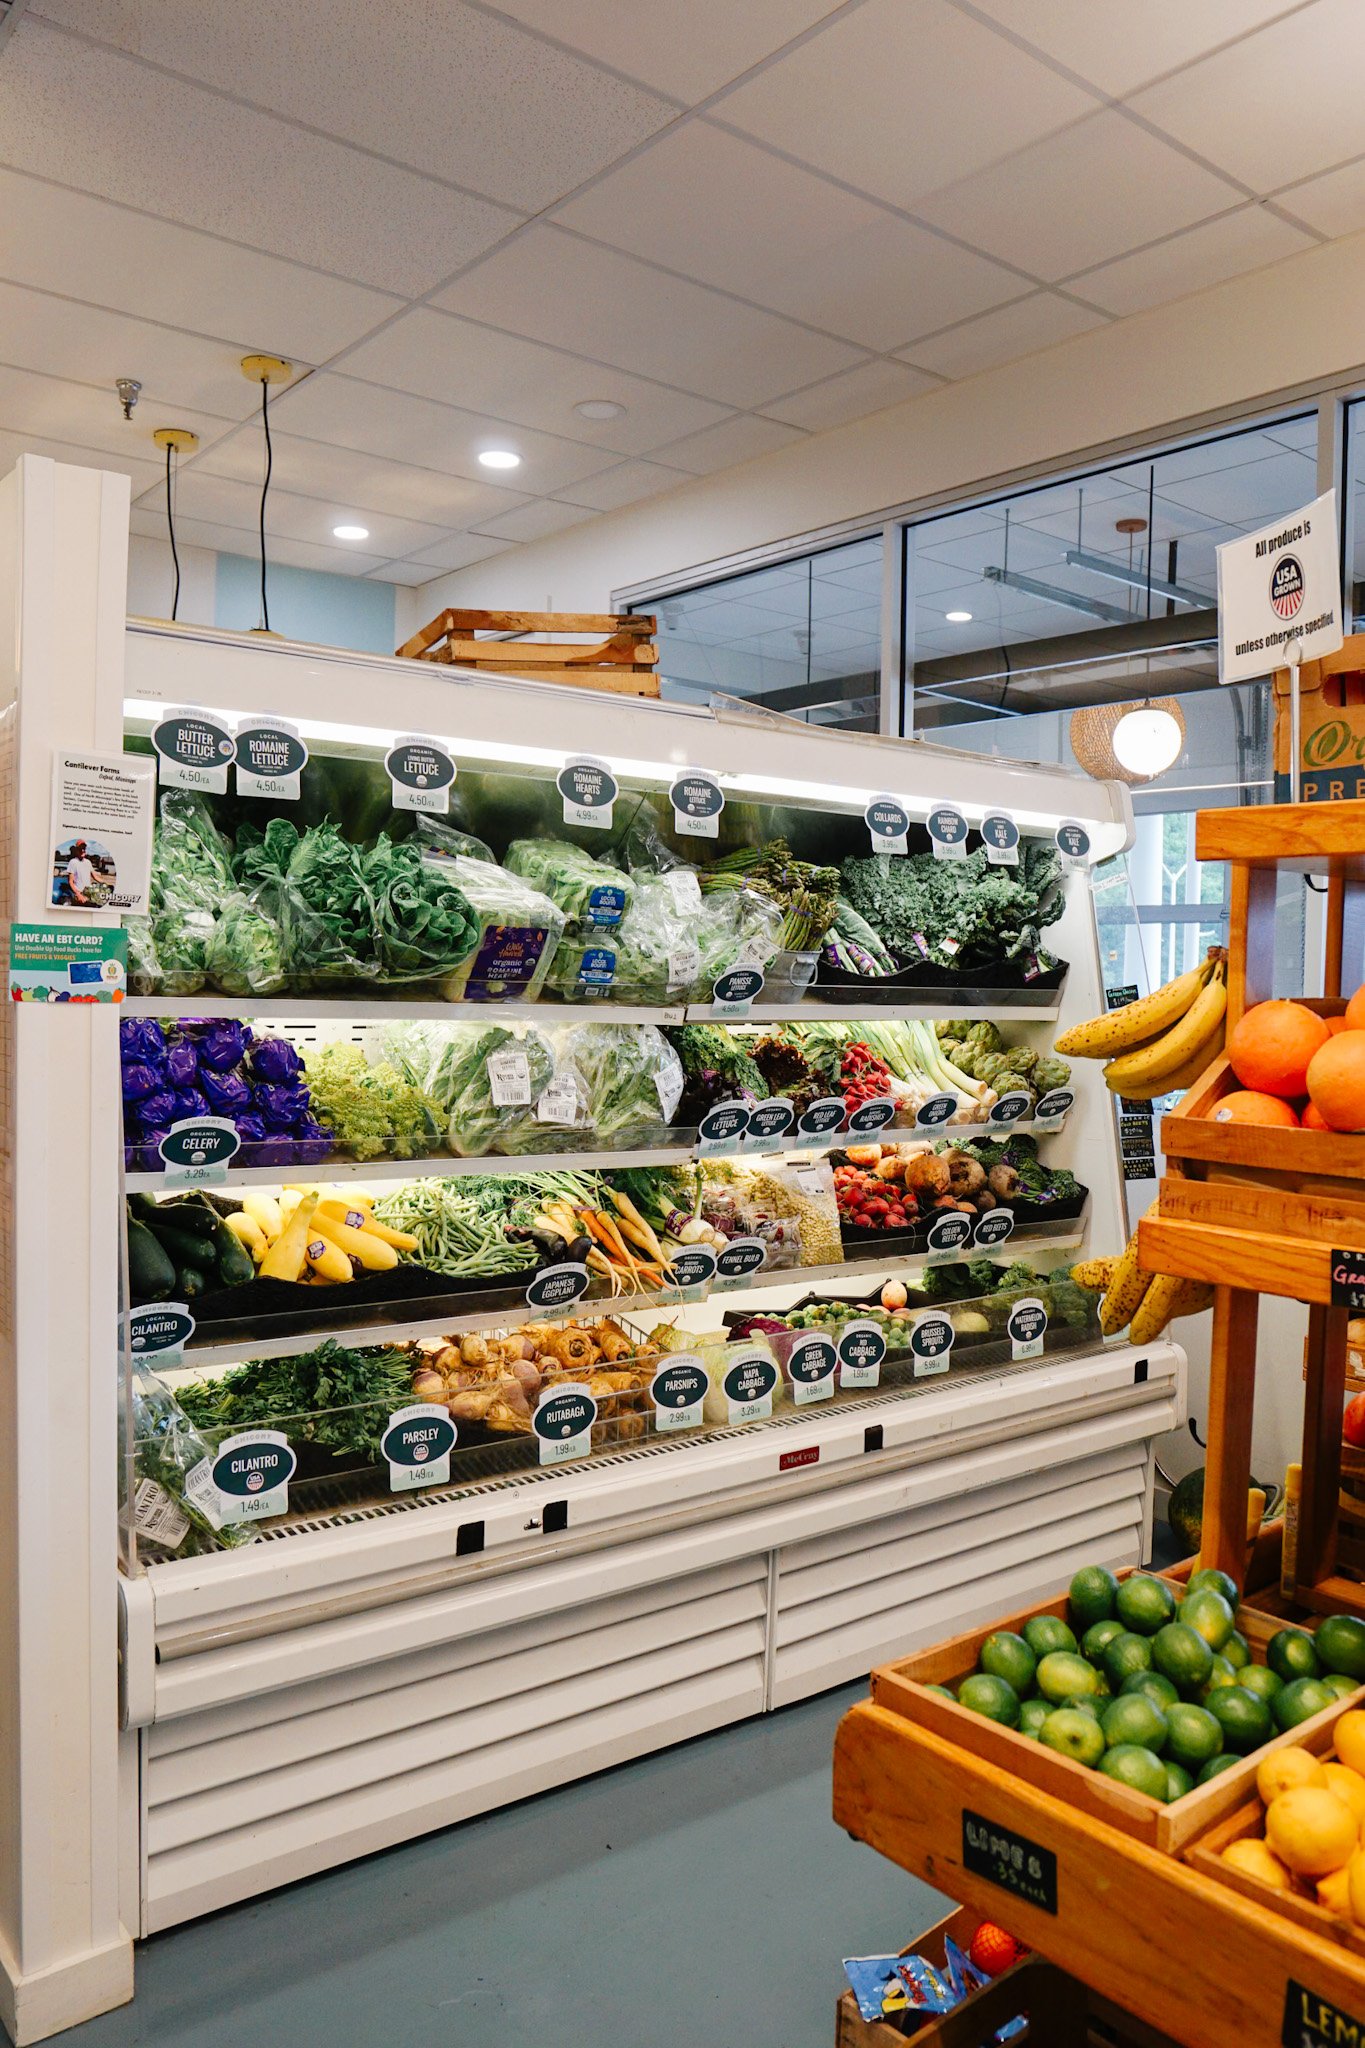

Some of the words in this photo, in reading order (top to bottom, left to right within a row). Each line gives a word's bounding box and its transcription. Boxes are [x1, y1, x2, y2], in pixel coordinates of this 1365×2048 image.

[1255, 539, 1266, 558] All
[1268, 527, 1303, 555] produce
[1303, 519, 1311, 535] is
[1276, 564, 1297, 585] USA
[1273, 577, 1301, 596] GROWN
[1235, 636, 1264, 656] unless
[1265, 624, 1304, 648] otherwise
[1305, 609, 1334, 635] specified
[186, 723, 206, 731] LOCAL
[178, 728, 214, 746] BUTTER
[176, 741, 215, 759] LETTUCE
[249, 740, 289, 754] ROMAINE
[252, 752, 289, 766] LETTUCE
[64, 760, 99, 772] Cantilever
[100, 765, 120, 775] Farms
[403, 760, 440, 776] LETTUCE
[573, 772, 602, 786] ROMAINE
[575, 783, 600, 795] HEARTS
[683, 785, 712, 799] ROMAINE
[874, 811, 902, 824] COLLARDS
[940, 824, 957, 834] CHARD
[994, 828, 1008, 839] KALE
[100, 893, 141, 903] CHICORY
[15, 933, 40, 943] HAVE
[41, 934, 54, 943] AN
[56, 935, 73, 944] EBT
[74, 935, 103, 945] CARD?
[492, 959, 522, 967] organic
[487, 967, 522, 975] ROMAINE
[728, 976, 754, 986] PANISSE
[1001, 1103, 1021, 1113] LEEKS
[1040, 1097, 1071, 1110] ARTICHOKES
[756, 1113, 774, 1122] GREEN
[774, 1112, 786, 1120] LEAF
[813, 1111, 824, 1119] RED
[824, 1110, 837, 1118] LEAF
[859, 1113, 886, 1123] RADISHES
[711, 1118, 739, 1131] LETTUCE
[182, 1137, 221, 1150] CELERY
[941, 1225, 961, 1236] GOLDEN
[981, 1224, 993, 1233] RED
[993, 1222, 1008, 1231] BEETS
[941, 1234, 956, 1243] BEETS
[721, 1255, 743, 1264] FENNEL
[743, 1253, 760, 1263] BULB
[675, 1265, 705, 1275] CARROTS
[544, 1277, 576, 1291] JAPANESE
[541, 1286, 576, 1299] EGGPLANT
[145, 1315, 165, 1323] LOCAL
[1015, 1312, 1042, 1325] WATERMELON
[131, 1320, 178, 1336] CILANTRO
[920, 1326, 946, 1339] BRUSSELS
[921, 1336, 944, 1347] SPROUTS
[804, 1349, 823, 1362] GREEN
[848, 1345, 877, 1357] CABBAGE
[801, 1358, 826, 1372] CABBAGE
[743, 1368, 760, 1379] NAPA
[665, 1378, 698, 1392] PARSNIPS
[737, 1376, 765, 1391] CABBAGE
[554, 1397, 577, 1405] ORGANIC
[546, 1405, 585, 1424] RUTABAGA
[402, 1427, 439, 1445] PARSLEY
[231, 1454, 278, 1473] CILANTRO
